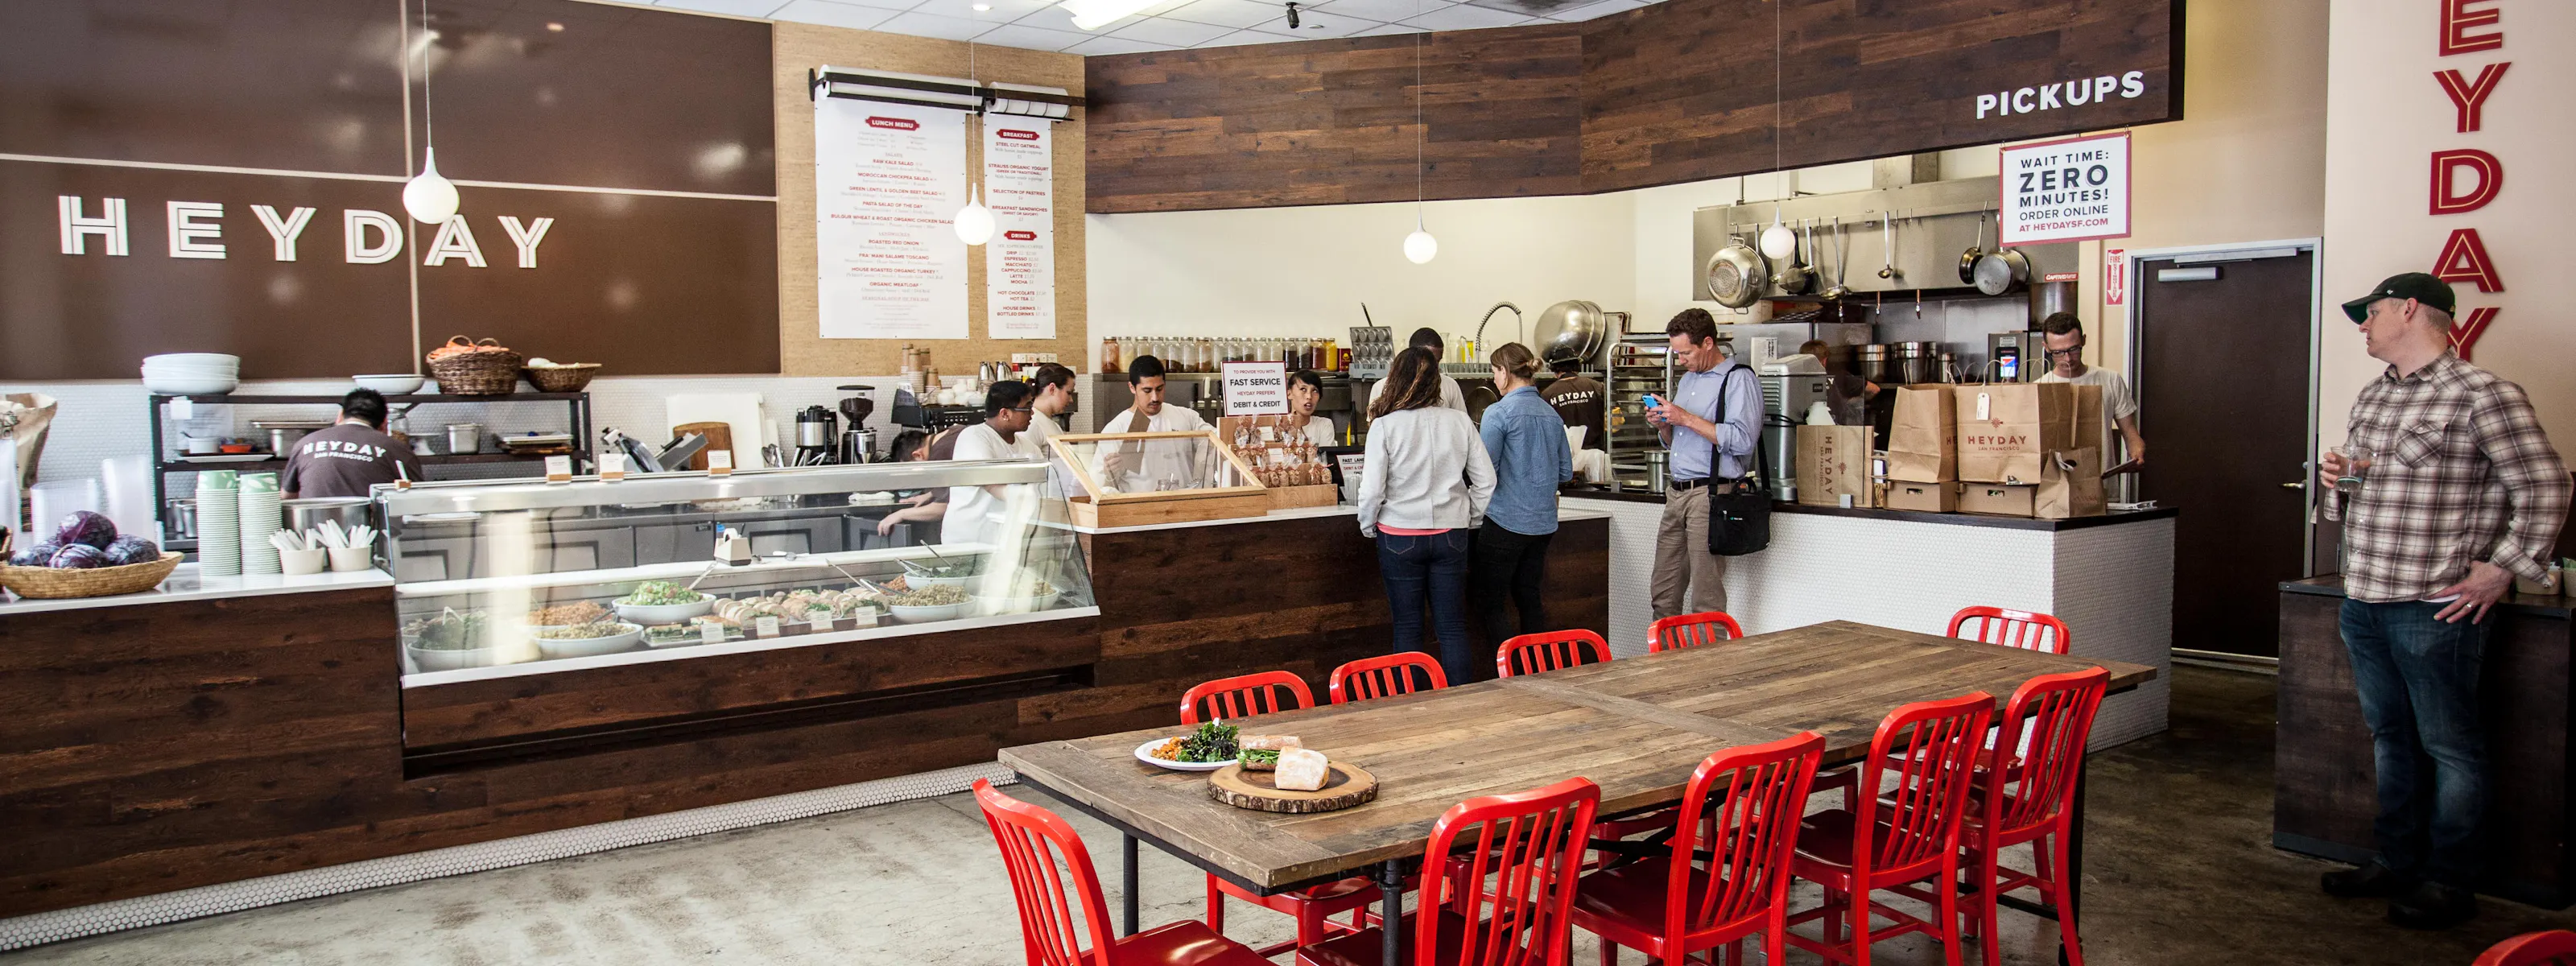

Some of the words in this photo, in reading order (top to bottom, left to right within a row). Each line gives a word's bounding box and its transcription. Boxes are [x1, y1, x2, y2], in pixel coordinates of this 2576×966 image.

[1976, 70, 2145, 120] PICKUPS
[895, 121, 914, 129] MENU
[2021, 155, 2058, 169] WAIT
[2066, 150, 2109, 163] TIME:
[2019, 164, 2108, 193] ZERO
[2020, 188, 2108, 208] MINUTES!
[2020, 209, 2059, 221] ORDER
[2063, 204, 2108, 217] ONLINE
[58, 195, 555, 269] HEYDAY
[2019, 225, 2030, 233] AT
[2033, 218, 2108, 231] HEYDAYSF.COM
[1250, 378, 1281, 386] SERVICE
[1550, 390, 1594, 406] HEYDAY
[303, 440, 387, 458] HEYDAY
[1968, 436, 2027, 445] HEYDAY
[328, 452, 374, 463] FRANCISCO
[1825, 436, 1833, 494] HEYDAY
